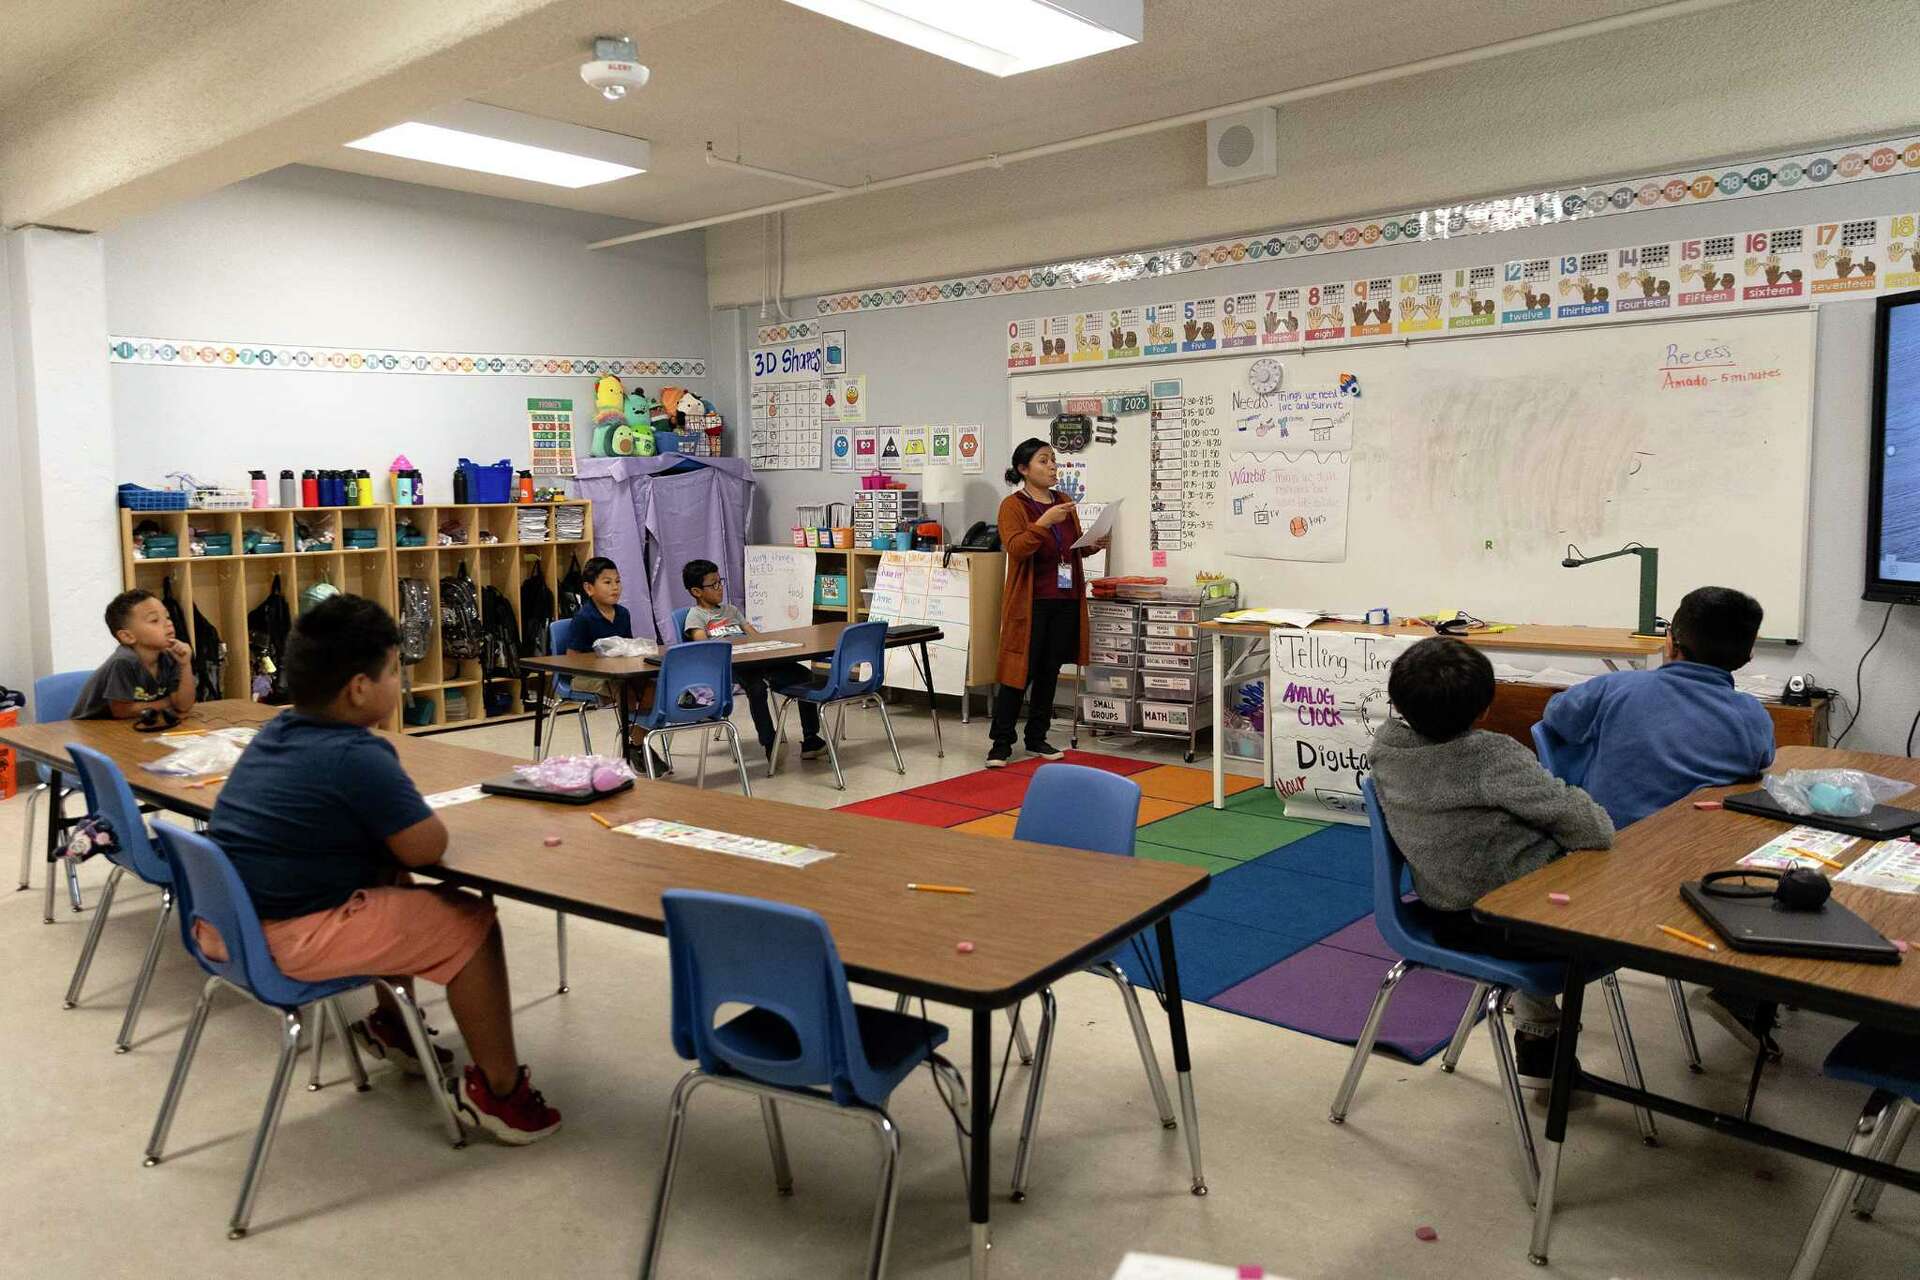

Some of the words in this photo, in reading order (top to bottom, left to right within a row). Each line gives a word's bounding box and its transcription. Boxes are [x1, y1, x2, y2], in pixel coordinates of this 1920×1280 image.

[1364, 228, 1378, 241] 83
[1384, 225, 1398, 237] 84
[1405, 222, 1419, 234] 85
[1614, 191, 1631, 205] 94
[1640, 188, 1656, 201] 95
[1667, 184, 1684, 199] 96
[1694, 180, 1712, 195] 97
[1722, 176, 1740, 190] 98
[1750, 172, 1769, 187] 99
[1780, 168, 1801, 182] 100
[1811, 163, 1828, 177] 101
[1841, 159, 1863, 173] 102
[1872, 153, 1895, 168] 103
[1816, 224, 1839, 246] 17
[1890, 214, 1915, 239] 18
[1681, 240, 1701, 261] 15
[1745, 232, 1767, 254] 16
[1560, 256, 1578, 275] 13
[1619, 248, 1638, 268] 14
[1455, 270, 1465, 288] 11
[1504, 263, 1521, 283] 12
[1354, 280, 1368, 300] 9
[1749, 286, 1794, 299] sixteen
[1812, 279, 1875, 293] seventeen
[1265, 291, 1276, 311] 7
[1308, 287, 1320, 306] 8
[1618, 298, 1669, 311] fourteen
[1685, 292, 1728, 304] fifteen
[1145, 306, 1156, 323] 4
[1184, 301, 1195, 320] 5
[1223, 297, 1235, 315] 6
[1562, 304, 1605, 316] thirteen
[1075, 314, 1084, 333] 2
[1109, 311, 1119, 328] 3
[1455, 316, 1488, 328] eleven
[1509, 310, 1544, 321] twelve
[1009, 322, 1018, 339] 0
[1043, 318, 1048, 335] 1
[1314, 328, 1336, 340] eight
[1361, 326, 1380, 335] nine
[1191, 341, 1207, 350] five
[1666, 343, 1732, 364] Recess
[754, 352, 777, 377] 3D
[1662, 371, 1708, 391] Amado
[1730, 369, 1781, 383] minutes
[1318, 389, 1338, 399] need
[1124, 398, 1147, 411] 2025
[1295, 401, 1310, 410] and
[1485, 540, 1493, 549] R
[1278, 635, 1348, 679] Telling
[1353, 637, 1393, 673] Tim
[1282, 682, 1335, 706] ANALOG
[1093, 699, 1116, 710] SMALL
[1090, 710, 1119, 721] GROUPS
[1144, 710, 1168, 722] MATH
[1296, 740, 1371, 772] Digita
[1275, 775, 1307, 799] Hour
